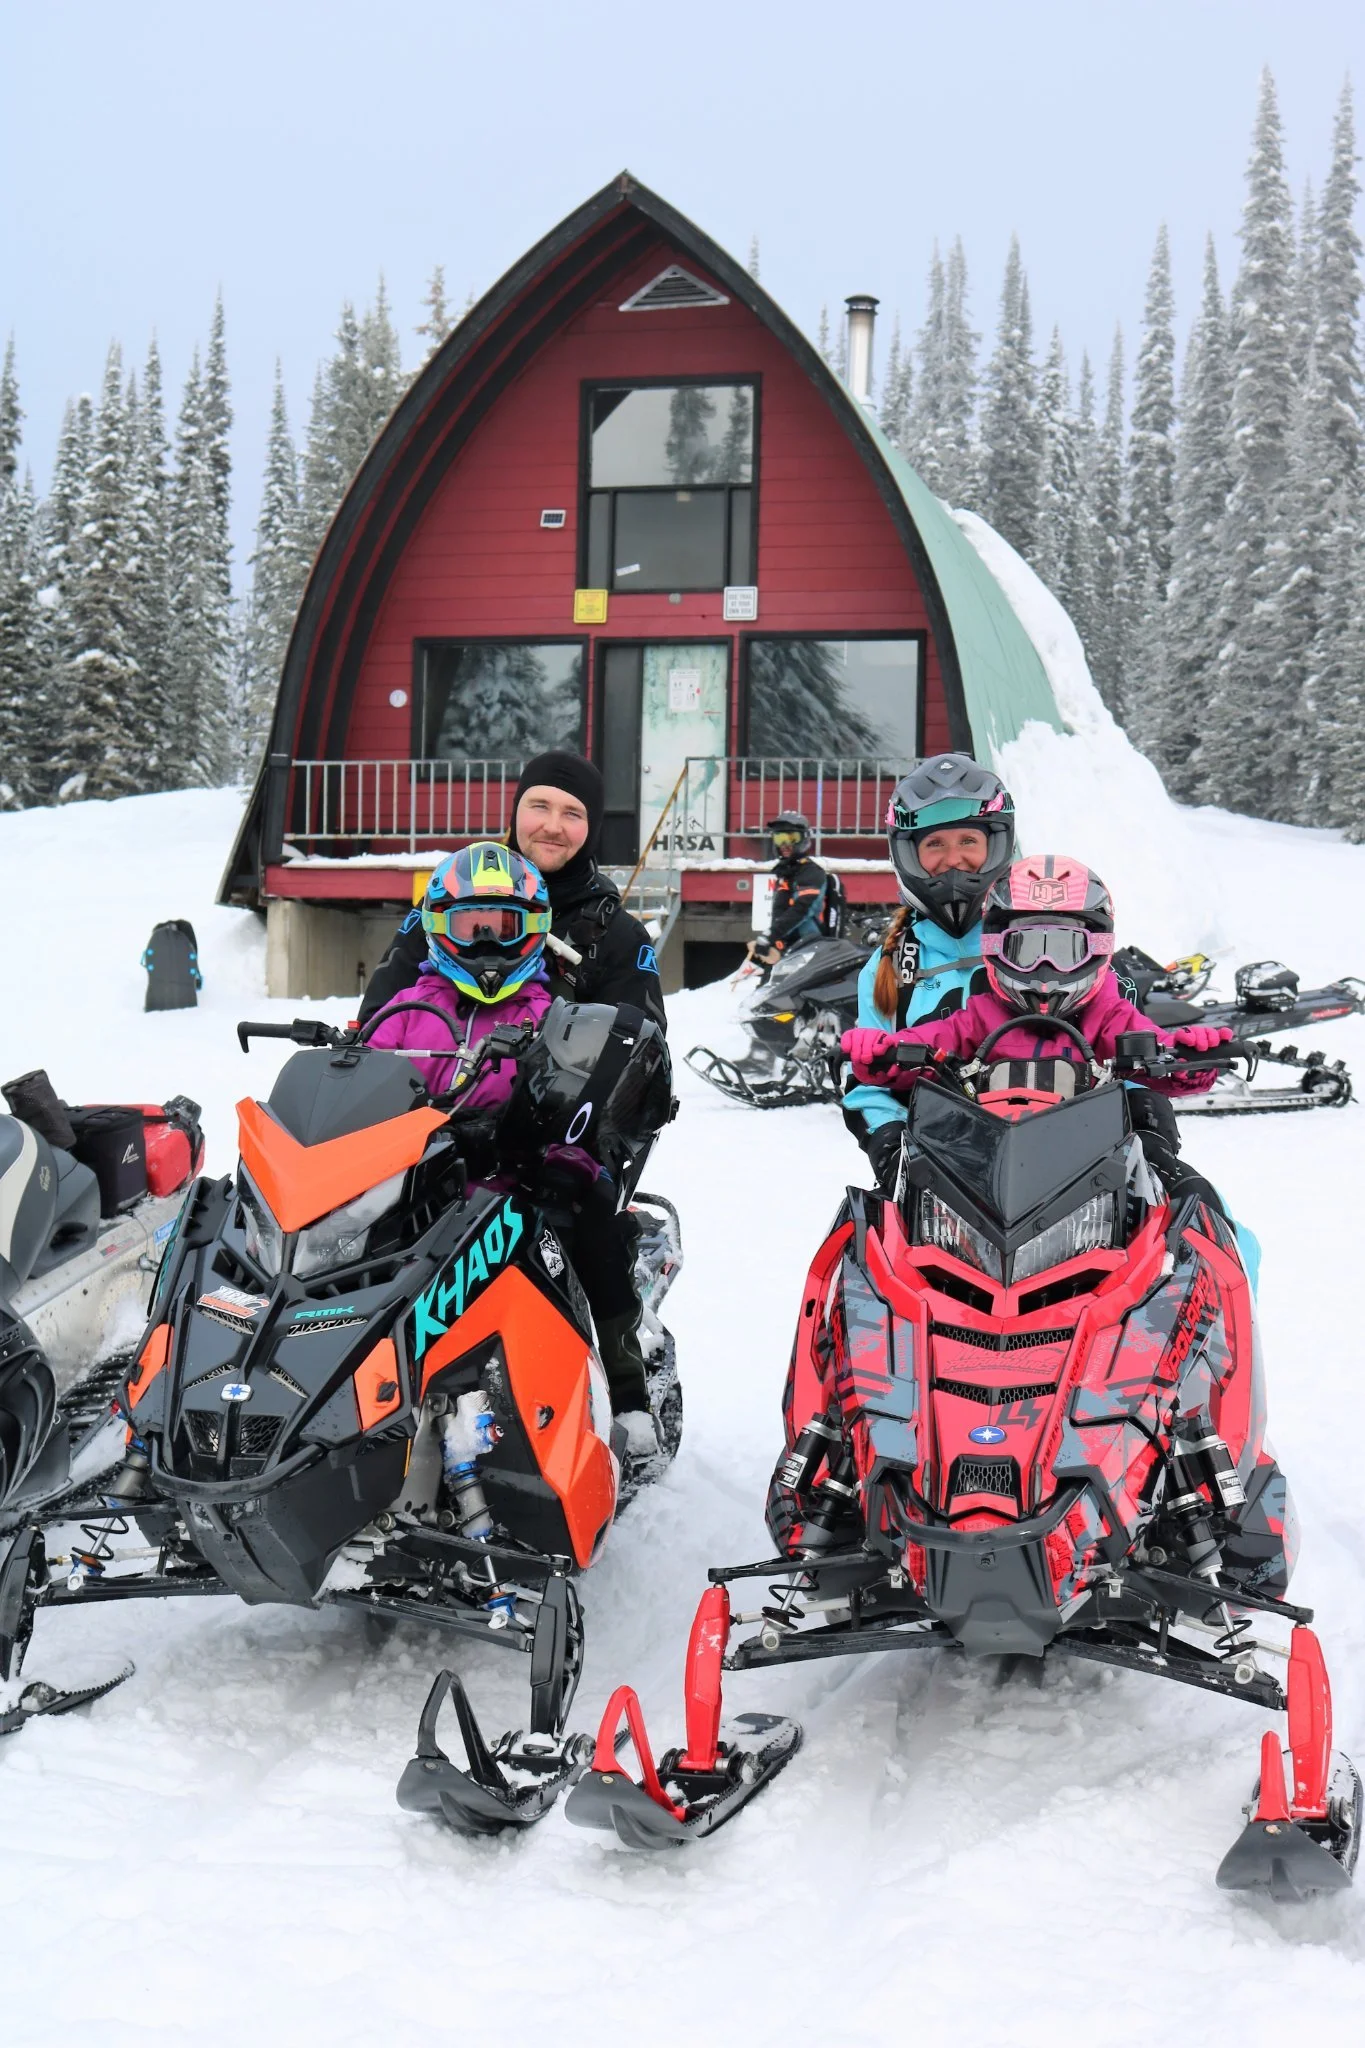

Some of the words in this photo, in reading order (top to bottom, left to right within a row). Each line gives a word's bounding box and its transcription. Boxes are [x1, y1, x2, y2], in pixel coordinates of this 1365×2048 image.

[652, 834, 716, 851] HRSA
[901, 942, 920, 984] bca
[413, 1195, 524, 1362] KHAOS
[294, 1305, 356, 1320] RMK
[1166, 1269, 1210, 1381] POLARIS
